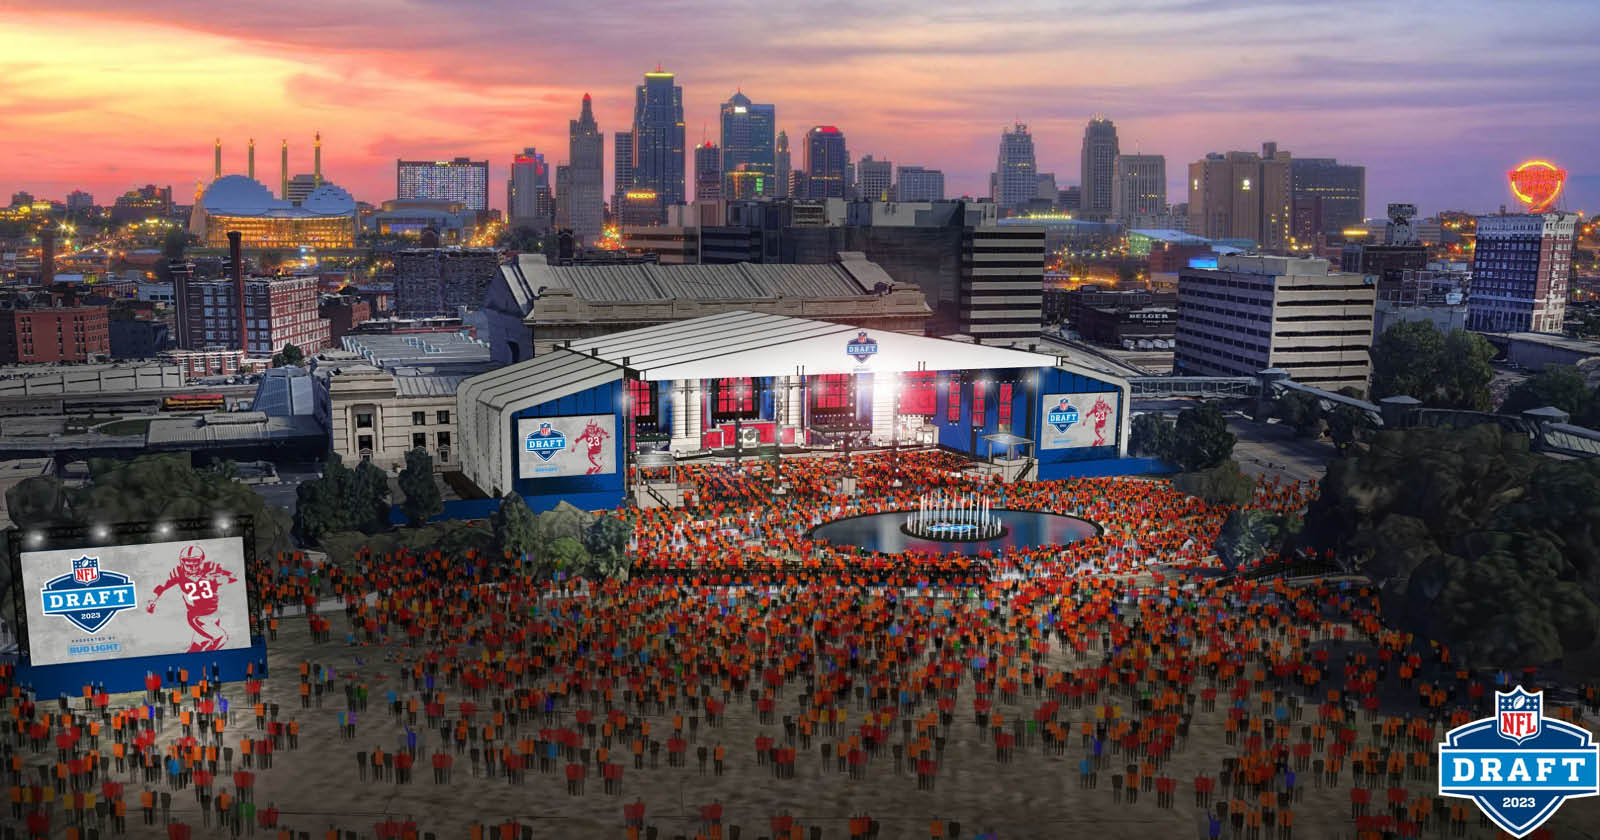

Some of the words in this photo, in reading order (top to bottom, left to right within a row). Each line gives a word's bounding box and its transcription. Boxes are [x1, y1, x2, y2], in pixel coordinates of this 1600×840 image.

[1050, 413, 1077, 422] DRAFT
[1095, 412, 1105, 422] 23
[529, 439, 563, 449] DRAFT
[587, 436, 600, 447] 23
[76, 567, 98, 581] NFL
[184, 580, 214, 600] 23
[50, 589, 128, 609] DRAFT
[81, 612, 101, 620] 2023
[69, 645, 90, 654] BUD
[91, 643, 120, 653] LIGHT
